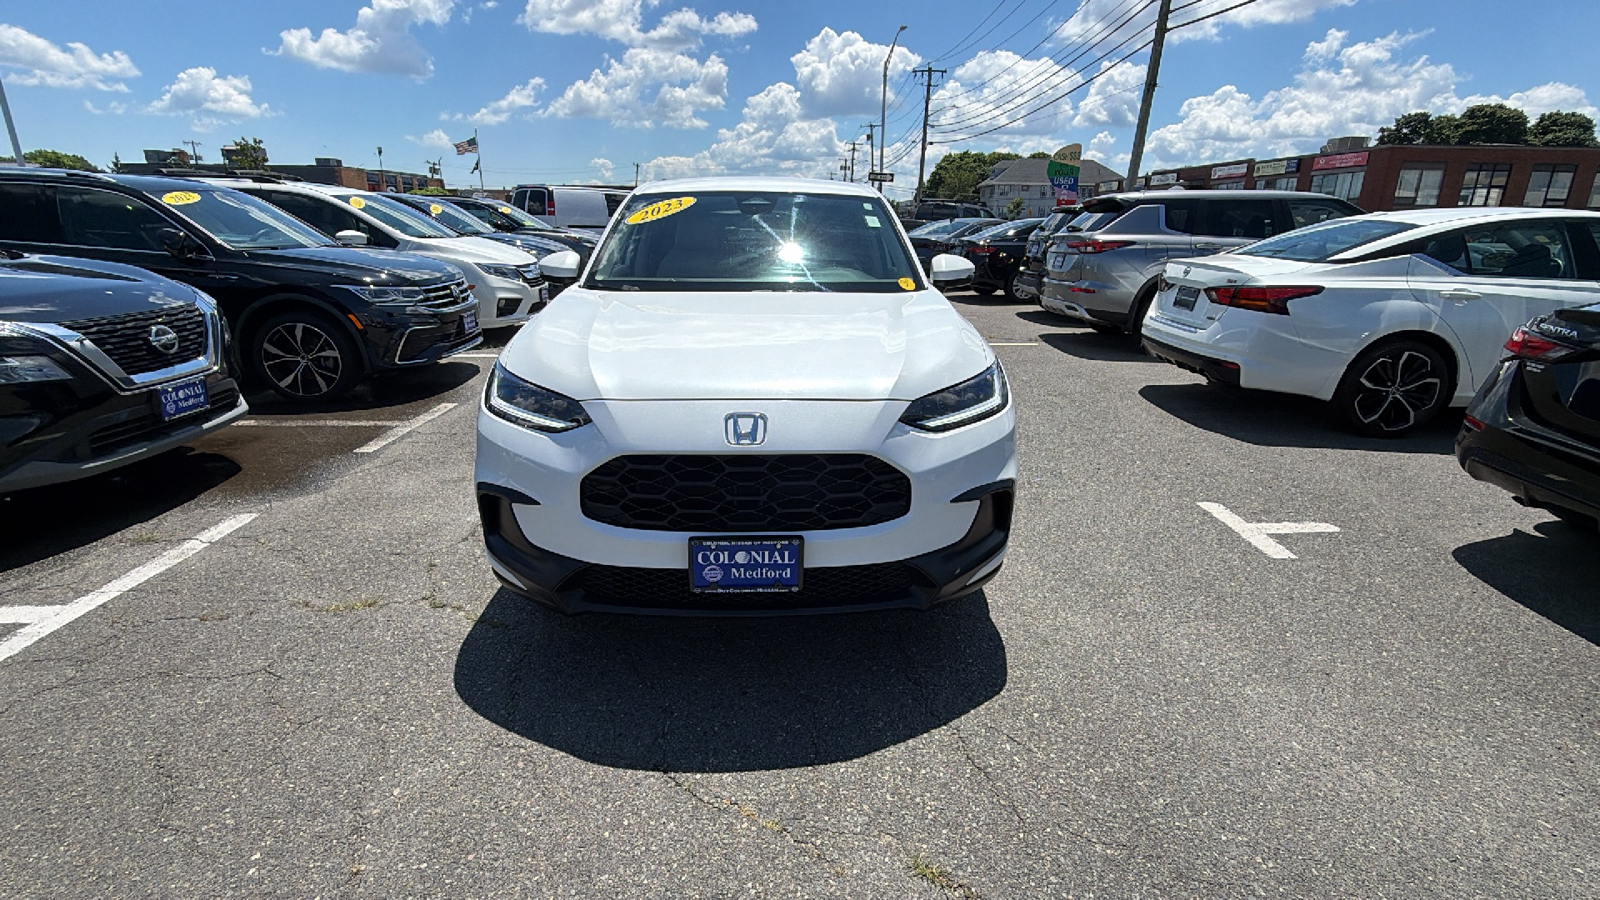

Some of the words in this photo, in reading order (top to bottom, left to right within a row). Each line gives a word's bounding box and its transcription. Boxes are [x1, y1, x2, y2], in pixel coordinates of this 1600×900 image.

[1053, 177, 1074, 185] USED
[640, 199, 683, 221] 2023
[1539, 323, 1578, 339] SENTRA
[161, 385, 206, 404] COLONIAL
[178, 395, 205, 409] Medford
[697, 550, 796, 565] COLONIAL
[731, 567, 791, 579] Medford
